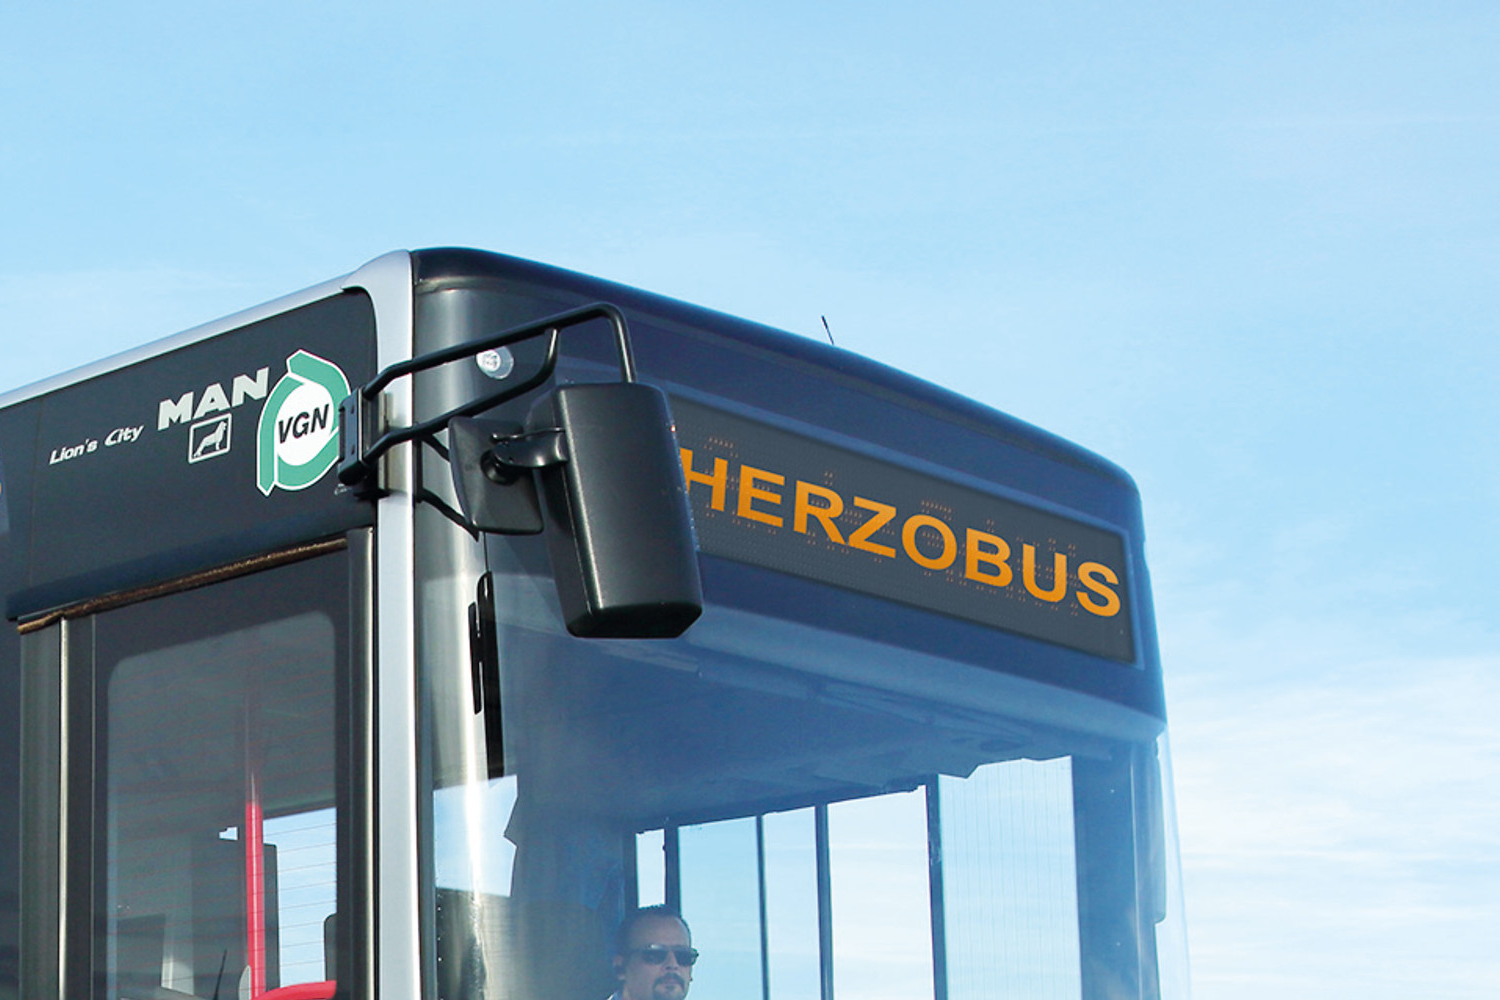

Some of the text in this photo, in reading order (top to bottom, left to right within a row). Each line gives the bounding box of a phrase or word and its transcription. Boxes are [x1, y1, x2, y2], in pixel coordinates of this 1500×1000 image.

[157, 367, 269, 431] MAN
[278, 404, 330, 444] VGN
[50, 424, 145, 465] Lion's City
[679, 447, 1121, 617] HERZOBUS
